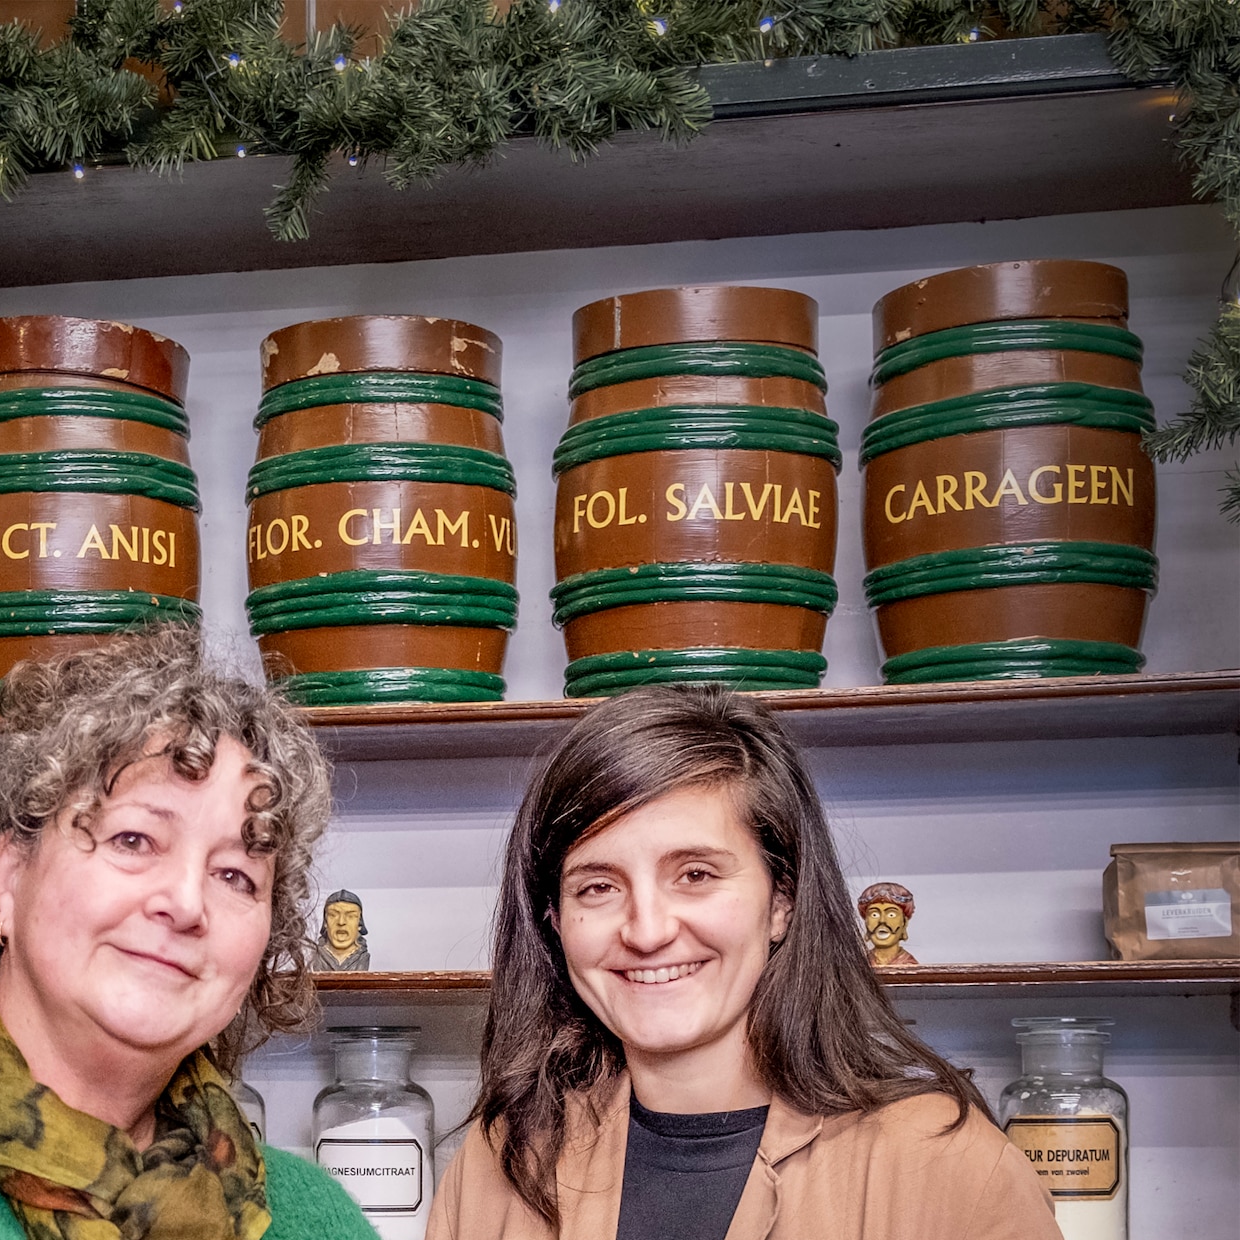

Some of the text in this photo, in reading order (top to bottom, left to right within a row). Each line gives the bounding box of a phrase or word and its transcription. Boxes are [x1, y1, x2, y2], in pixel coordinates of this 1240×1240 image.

[573, 482, 821, 533] FOL. SALVIAE
[885, 464, 1134, 524] CARRAGEEN
[76, 523, 176, 568] ANISI
[248, 514, 323, 563] FLOR.
[338, 507, 480, 549] CHAM.
[1047, 1149, 1110, 1162] DEPURATUM
[1066, 1166, 1090, 1176] zwavel
